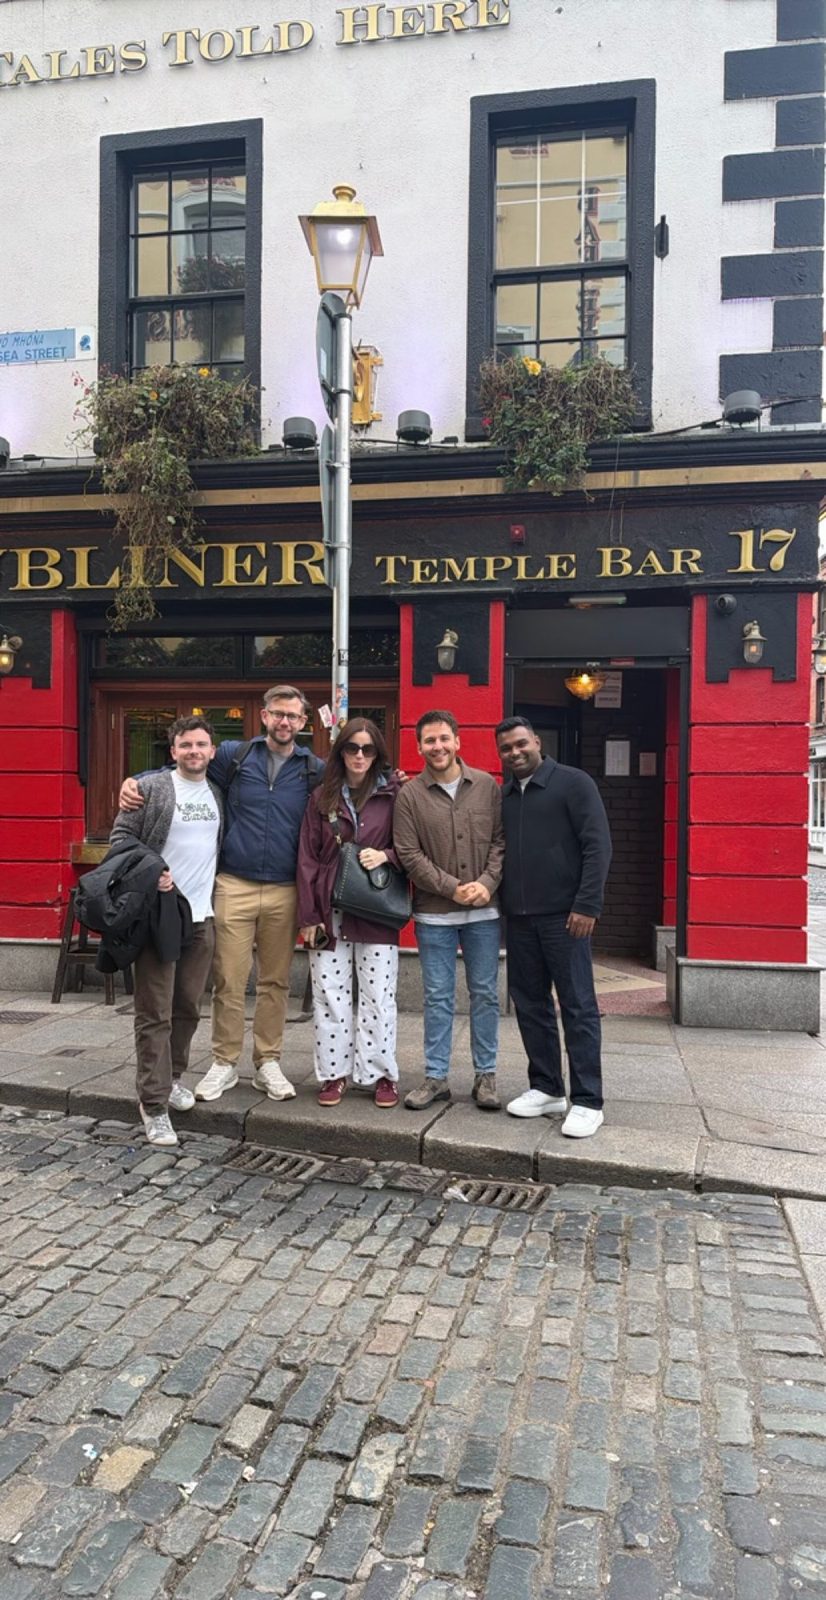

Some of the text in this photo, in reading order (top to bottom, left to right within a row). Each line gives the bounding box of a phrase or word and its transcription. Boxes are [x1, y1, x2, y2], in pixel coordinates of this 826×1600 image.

[162, 19, 315, 67] TOLD
[335, 0, 511, 45] HERE
[25, 346, 67, 360] STREET
[0, 528, 796, 591] BLINER TEMPLE BAR 17
